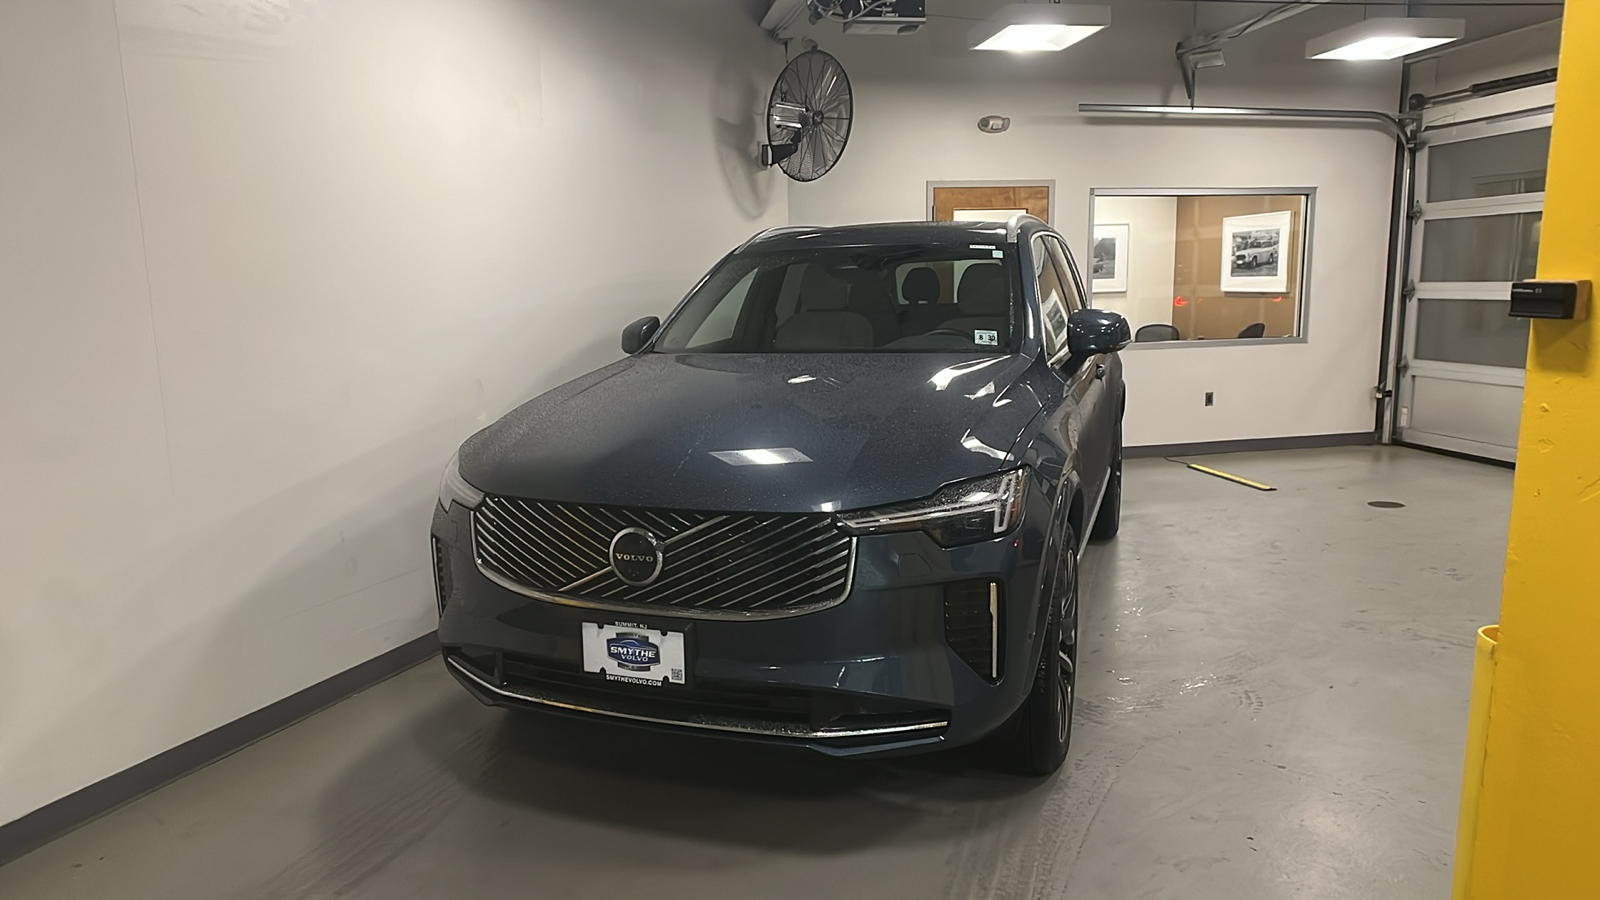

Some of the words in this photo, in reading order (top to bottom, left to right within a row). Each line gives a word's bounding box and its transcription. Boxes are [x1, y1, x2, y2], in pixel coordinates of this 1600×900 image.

[615, 552, 654, 562] VOLVO
[610, 646, 656, 658] SMYTHE
[621, 654, 648, 662] VOLVO
[606, 674, 662, 686] SMYTHEVOLVO.COM
